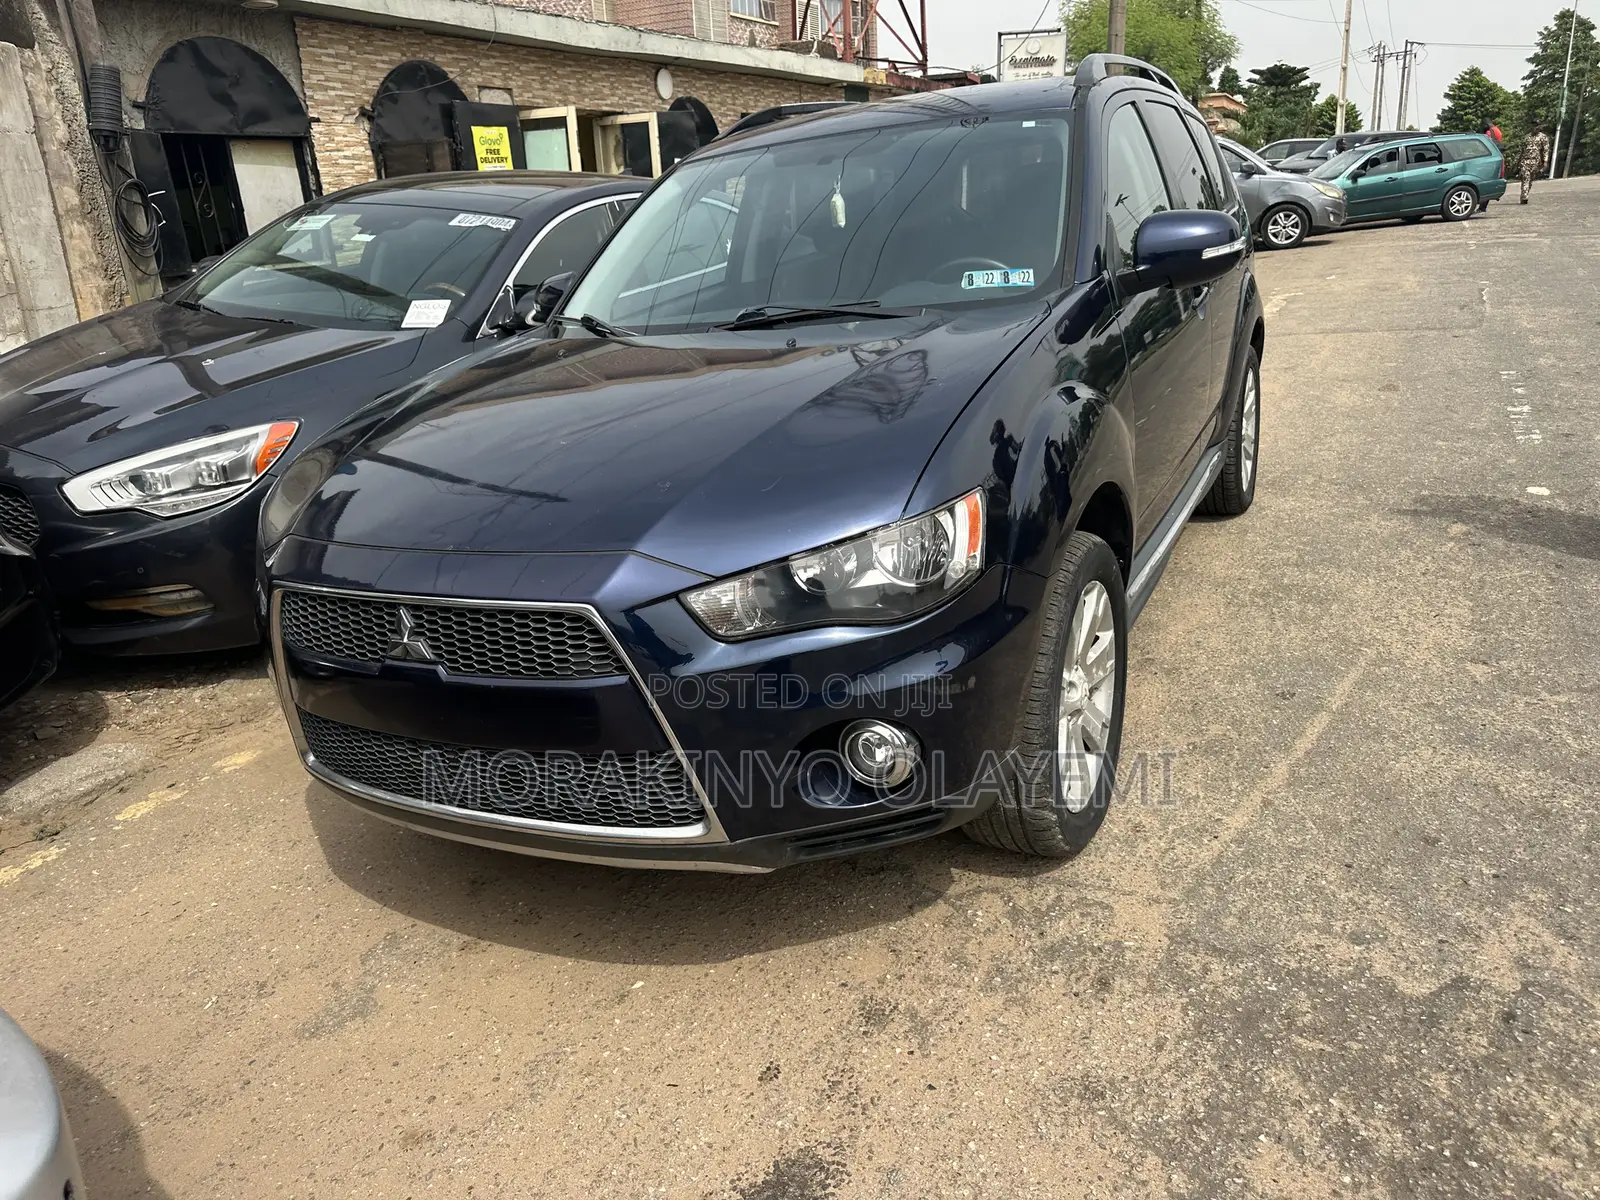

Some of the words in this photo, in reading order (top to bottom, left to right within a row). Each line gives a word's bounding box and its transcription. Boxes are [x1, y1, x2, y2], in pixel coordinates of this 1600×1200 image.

[479, 135, 502, 146] Glovo
[485, 148, 501, 156] FREE
[480, 156, 509, 164] DELIVERY
[967, 273, 974, 287] 8
[985, 272, 995, 285] 22
[1003, 271, 1010, 284] 8
[1021, 270, 1031, 283] 22
